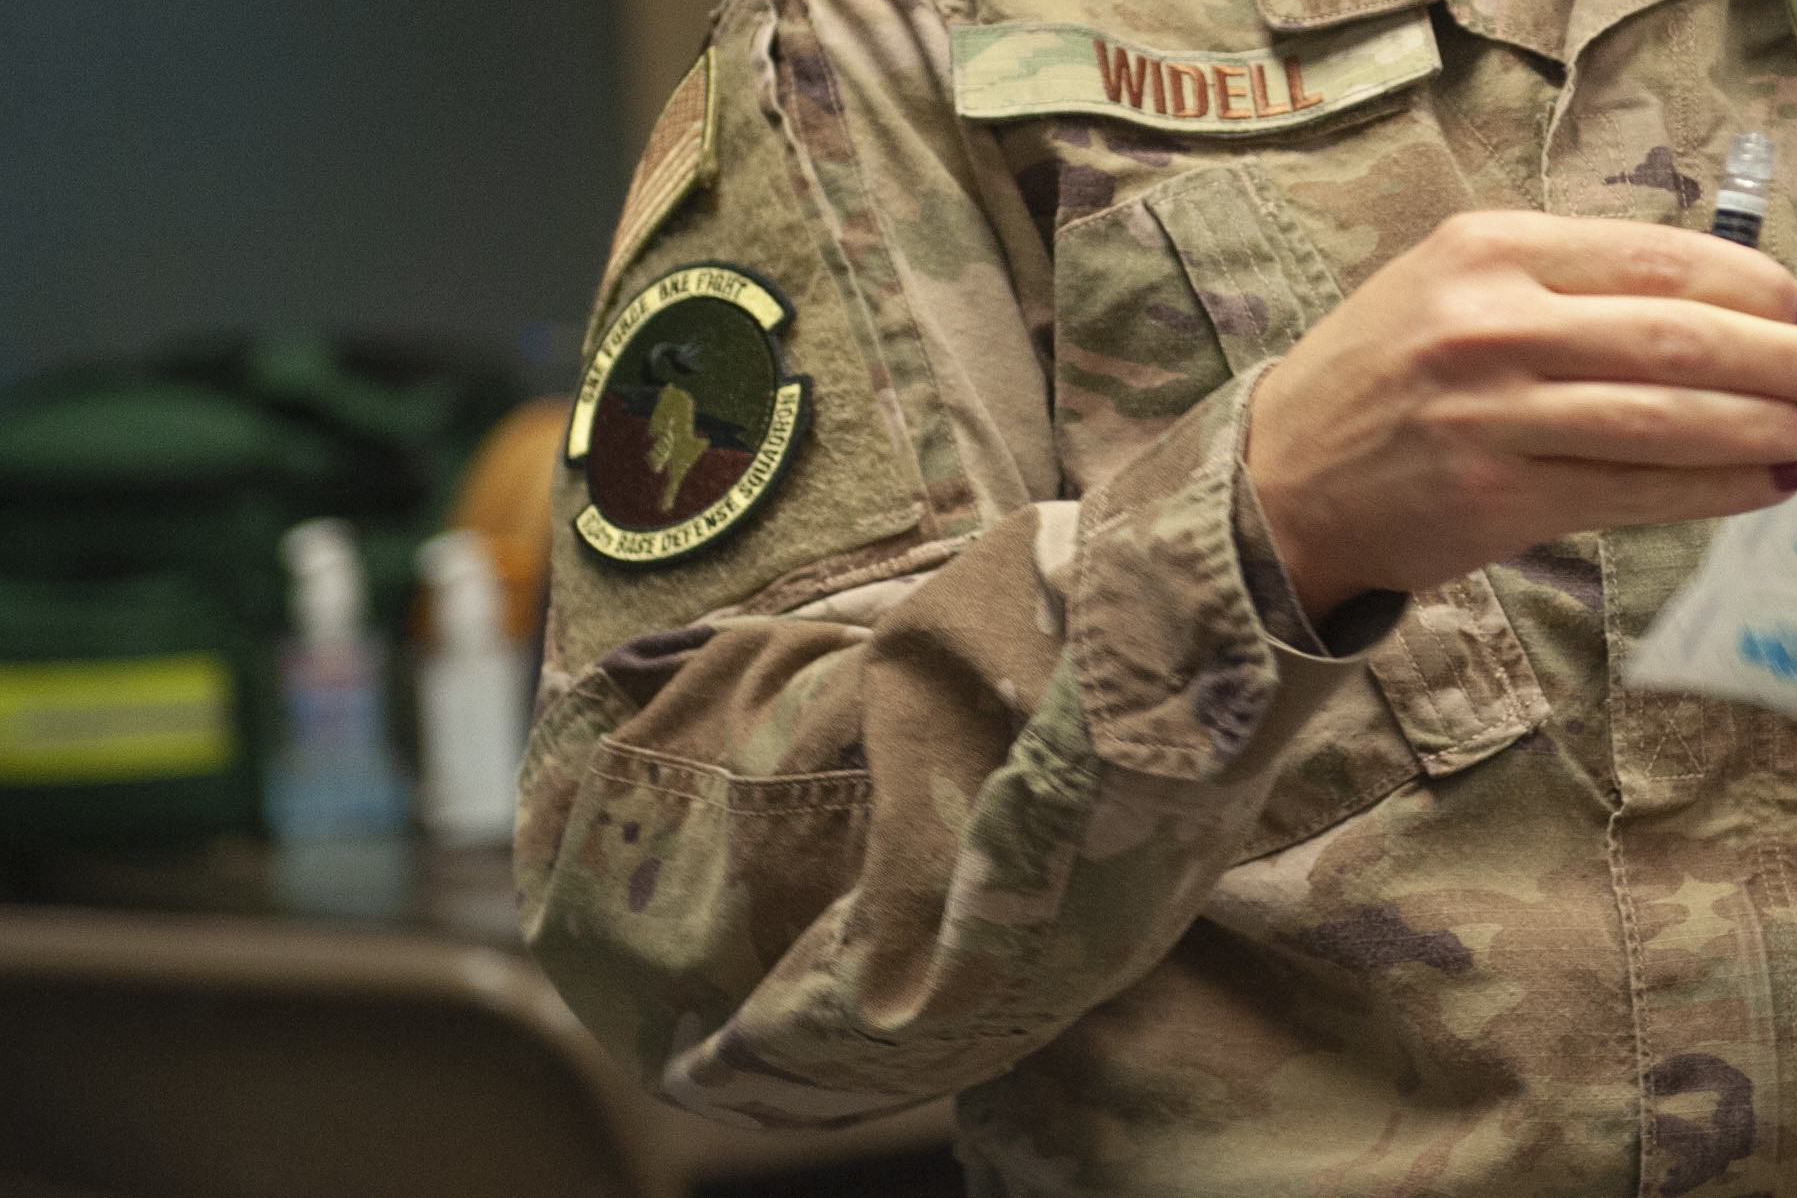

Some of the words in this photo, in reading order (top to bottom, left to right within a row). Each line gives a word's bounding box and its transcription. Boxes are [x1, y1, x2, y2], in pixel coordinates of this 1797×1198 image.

[1092, 39, 1324, 120] WIDELL
[657, 274, 690, 301] ONE
[696, 272, 748, 301] FIGHT
[614, 531, 655, 555] BASE
[658, 498, 739, 553] DEFENSE
[737, 392, 800, 499] SQUADRON
